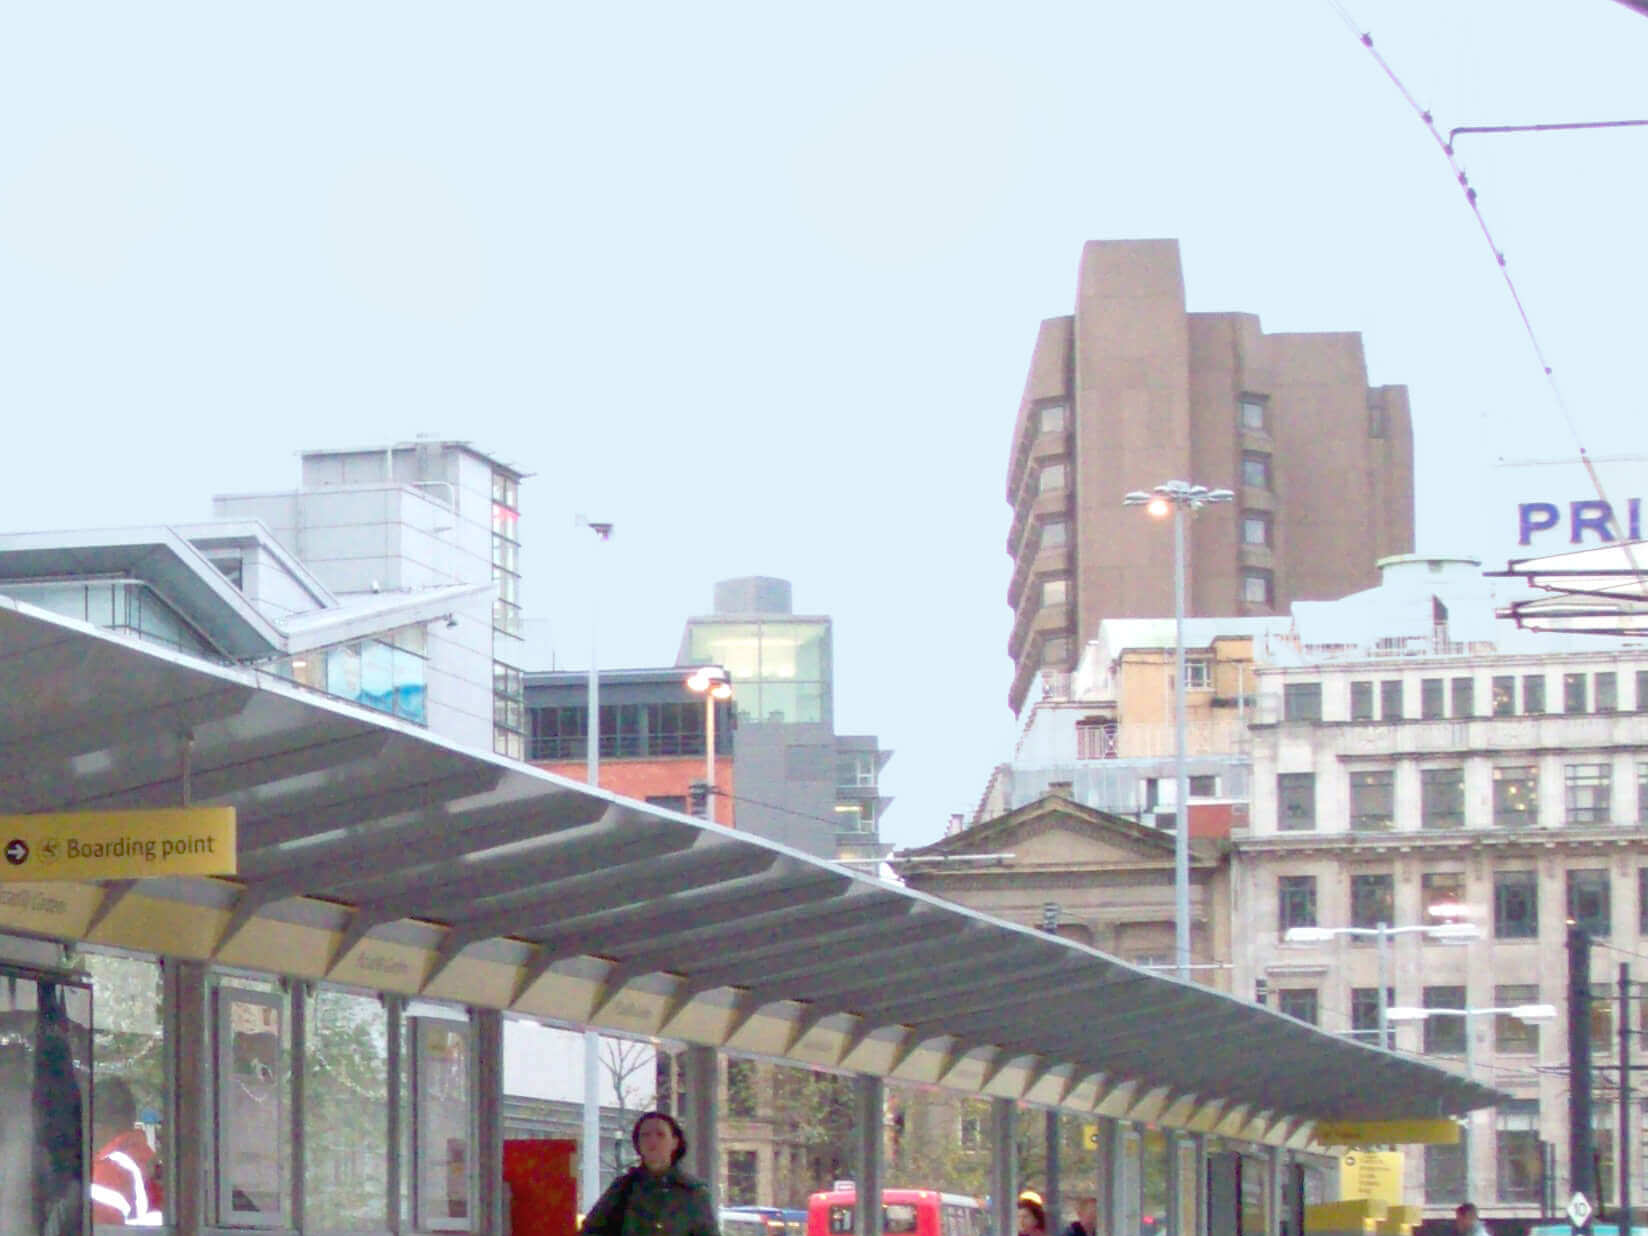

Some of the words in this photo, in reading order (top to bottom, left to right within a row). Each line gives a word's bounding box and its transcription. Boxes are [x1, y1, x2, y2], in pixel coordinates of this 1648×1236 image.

[1517, 498, 1642, 546] PRI
[67, 837, 156, 862] Boarding
[161, 834, 215, 861] point
